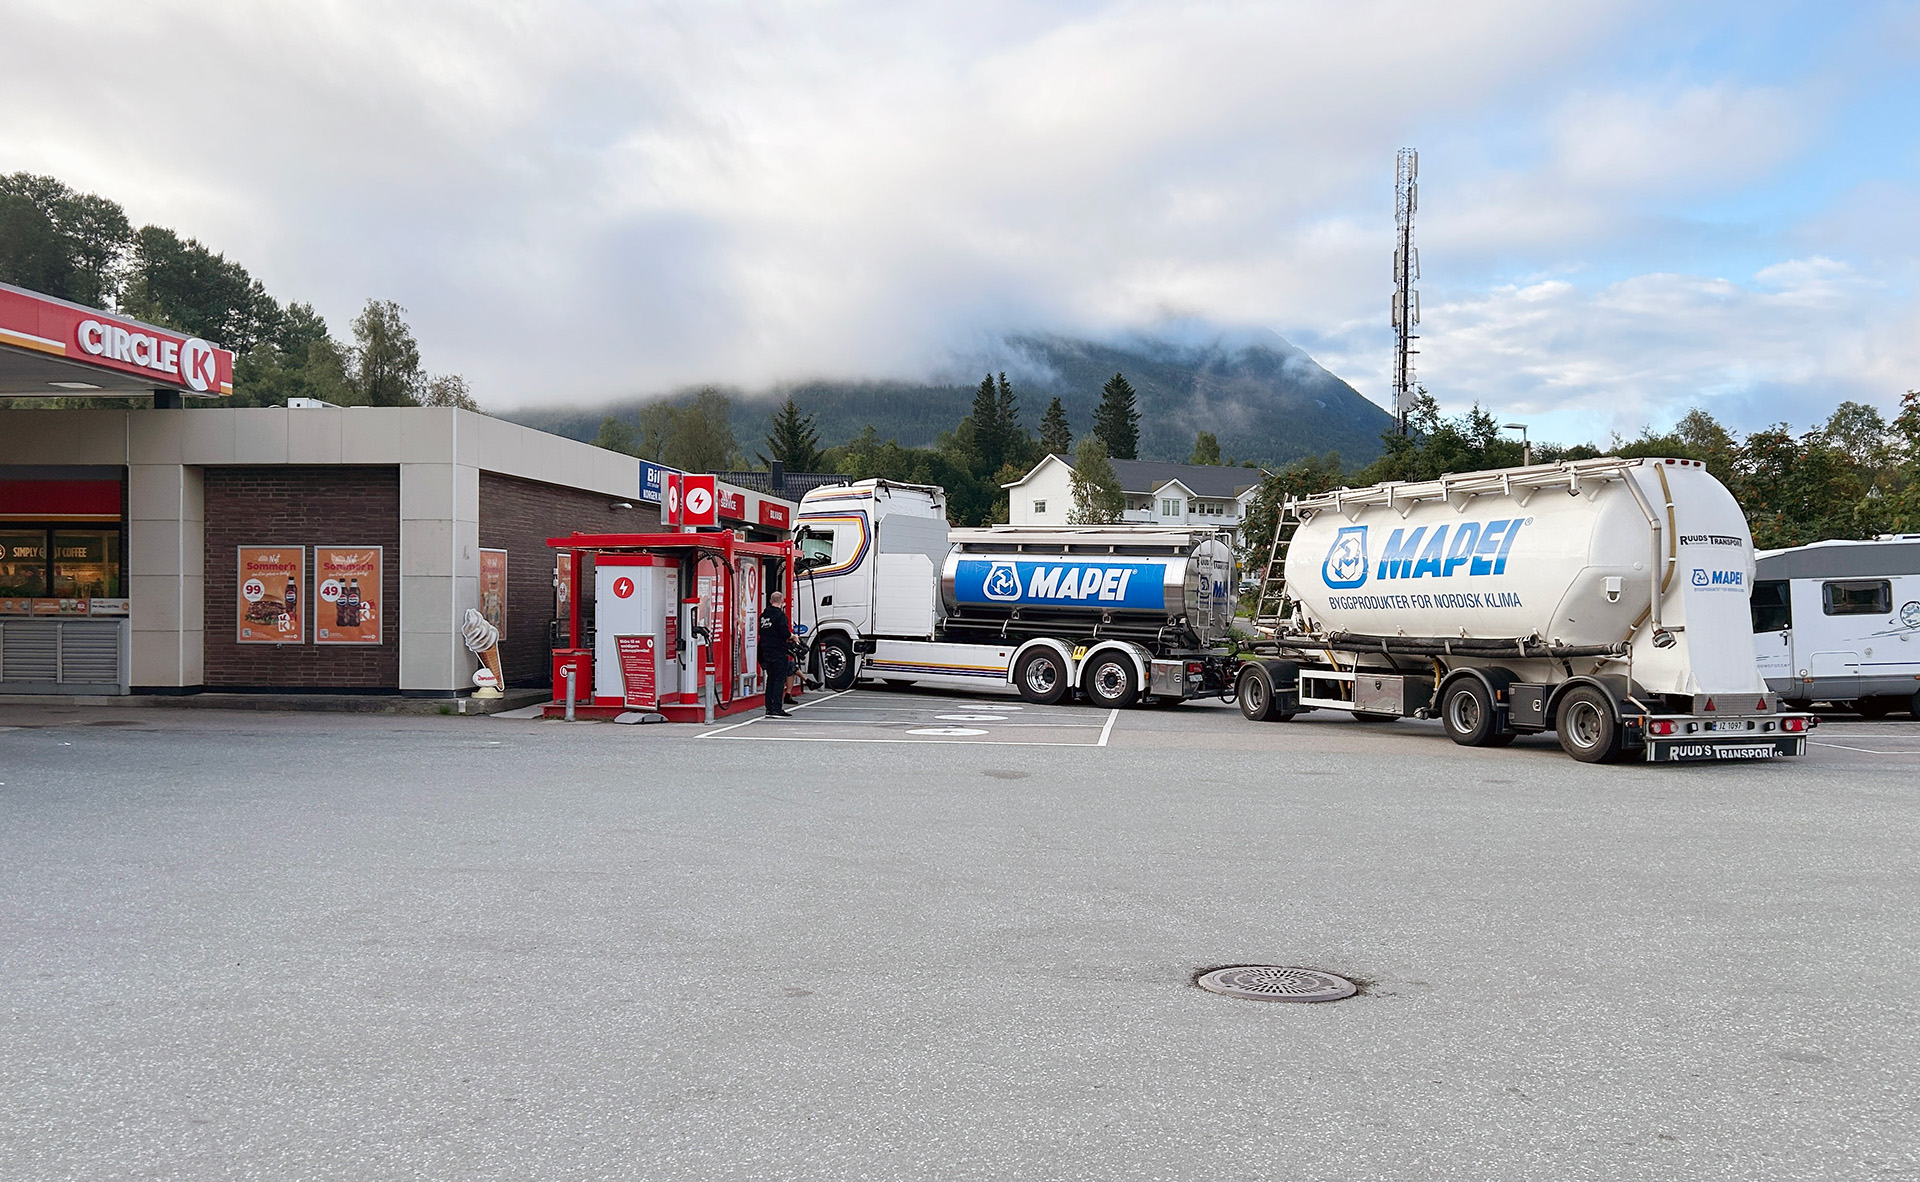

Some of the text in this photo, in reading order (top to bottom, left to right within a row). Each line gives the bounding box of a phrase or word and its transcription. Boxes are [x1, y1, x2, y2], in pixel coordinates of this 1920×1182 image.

[77, 319, 215, 391] CIRCLE K
[720, 498, 736, 511] SERVICE
[1679, 535, 1742, 547] RUUDS TRANSPORT
[13, 547, 38, 557] SIMPLY
[62, 547, 87, 557] COFFEE
[1376, 517, 1525, 580] MAPEI
[1027, 566, 1133, 601] MAPEI
[1711, 571, 1743, 585] MAPEI
[245, 585, 261, 595] 99
[322, 586, 339, 596] 49
[1328, 592, 1523, 610] BYGGPRODUKTER FOR NORDISK KLIMA
[1718, 721, 1742, 730] JZ 1097
[1669, 744, 1711, 760] RUUD'S
[1712, 743, 1776, 759] TRANSPORT
